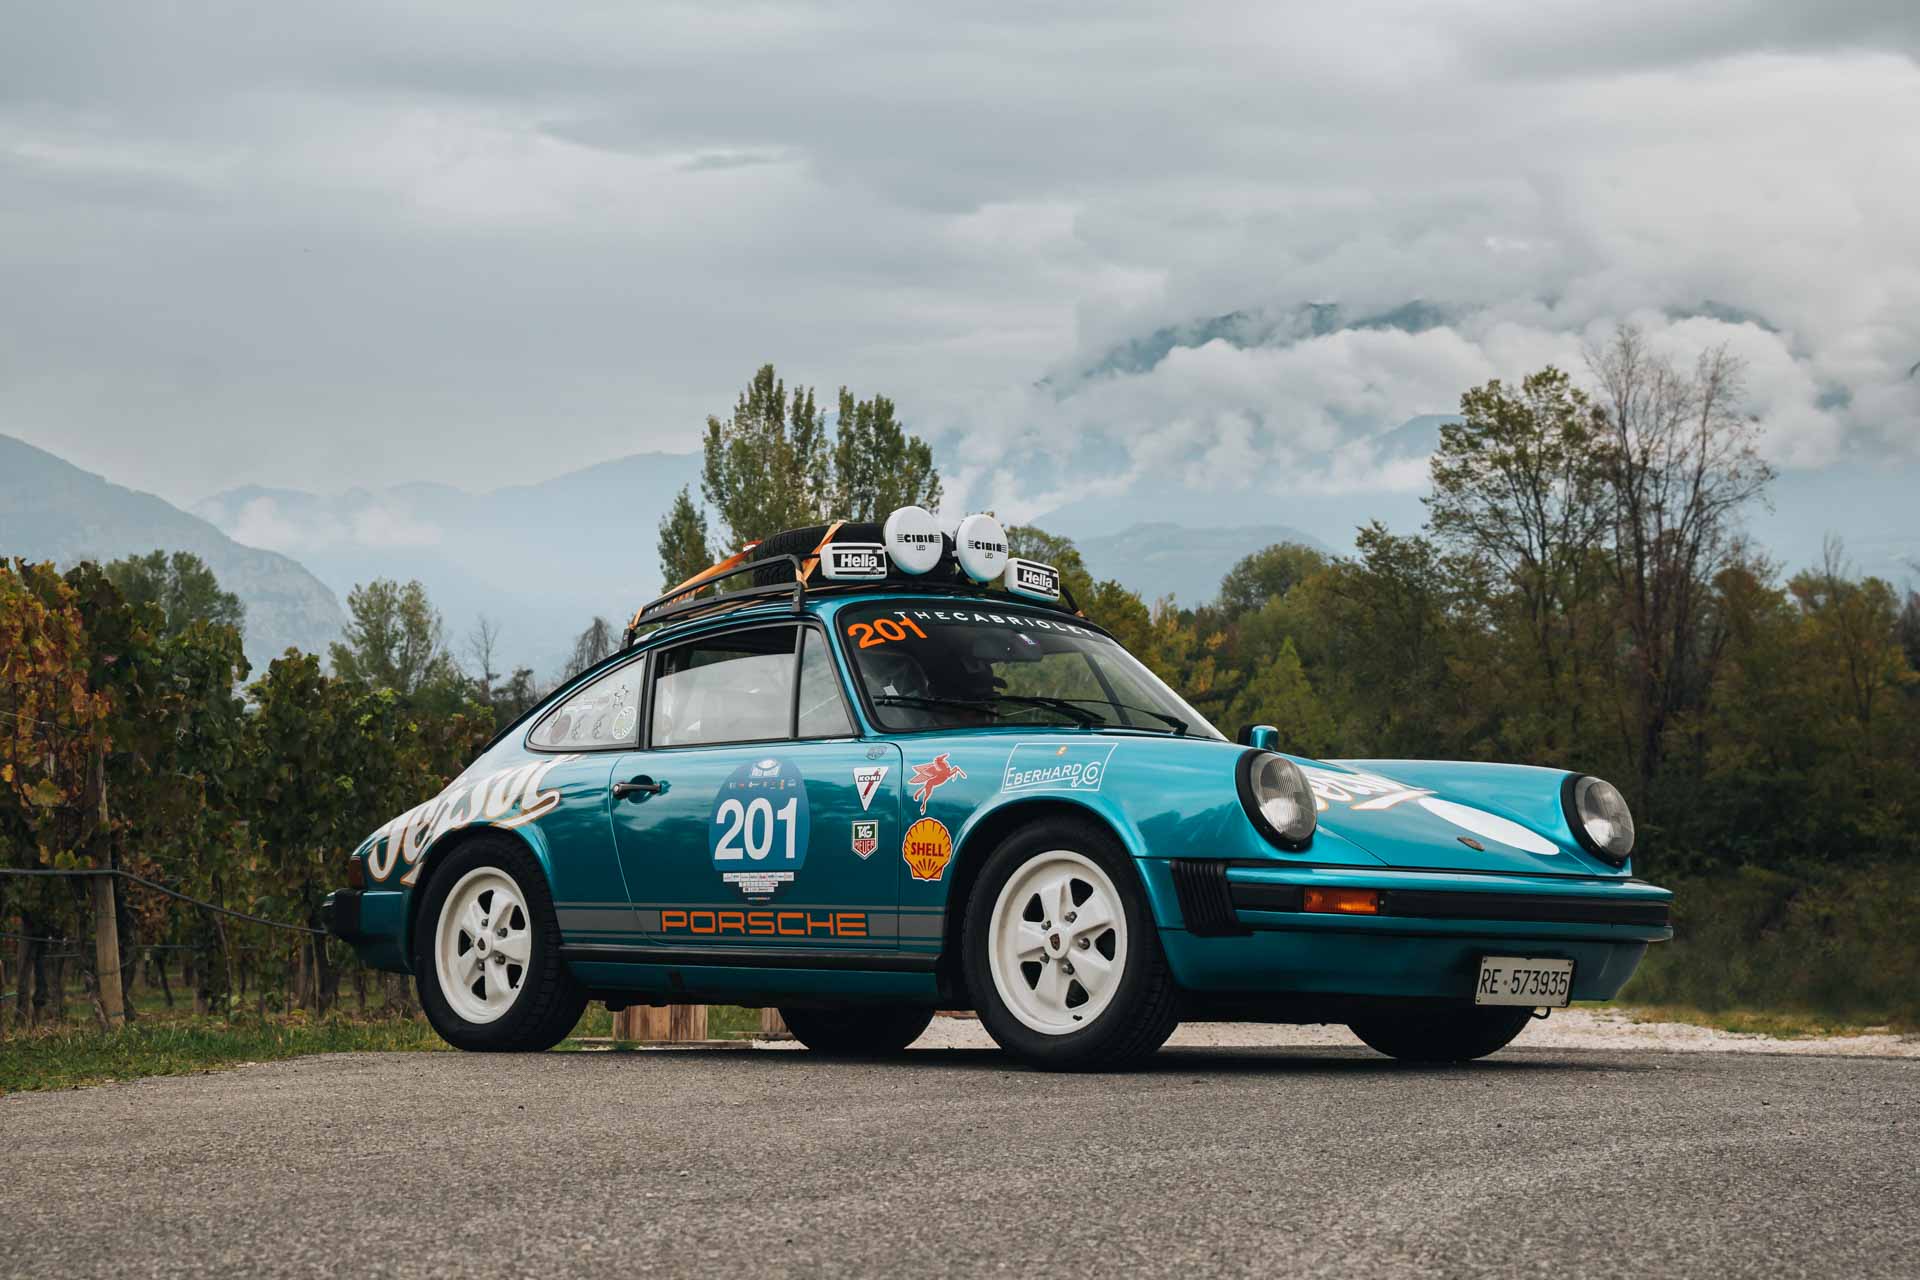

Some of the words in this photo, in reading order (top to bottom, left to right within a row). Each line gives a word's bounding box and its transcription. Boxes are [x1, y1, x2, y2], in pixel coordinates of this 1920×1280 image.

[840, 553, 878, 567] Hella
[1022, 569, 1053, 588] Hella
[847, 617, 928, 649] 201
[1005, 763, 1082, 787] EBERHARD
[714, 797, 798, 860] 201
[857, 825, 873, 838] TAG
[853, 840, 875, 854] HEUER
[911, 842, 944, 857] SHELL
[661, 911, 868, 936] PORSCHE
[1480, 968, 1502, 994] RE
[1510, 970, 1570, 995] 573935
